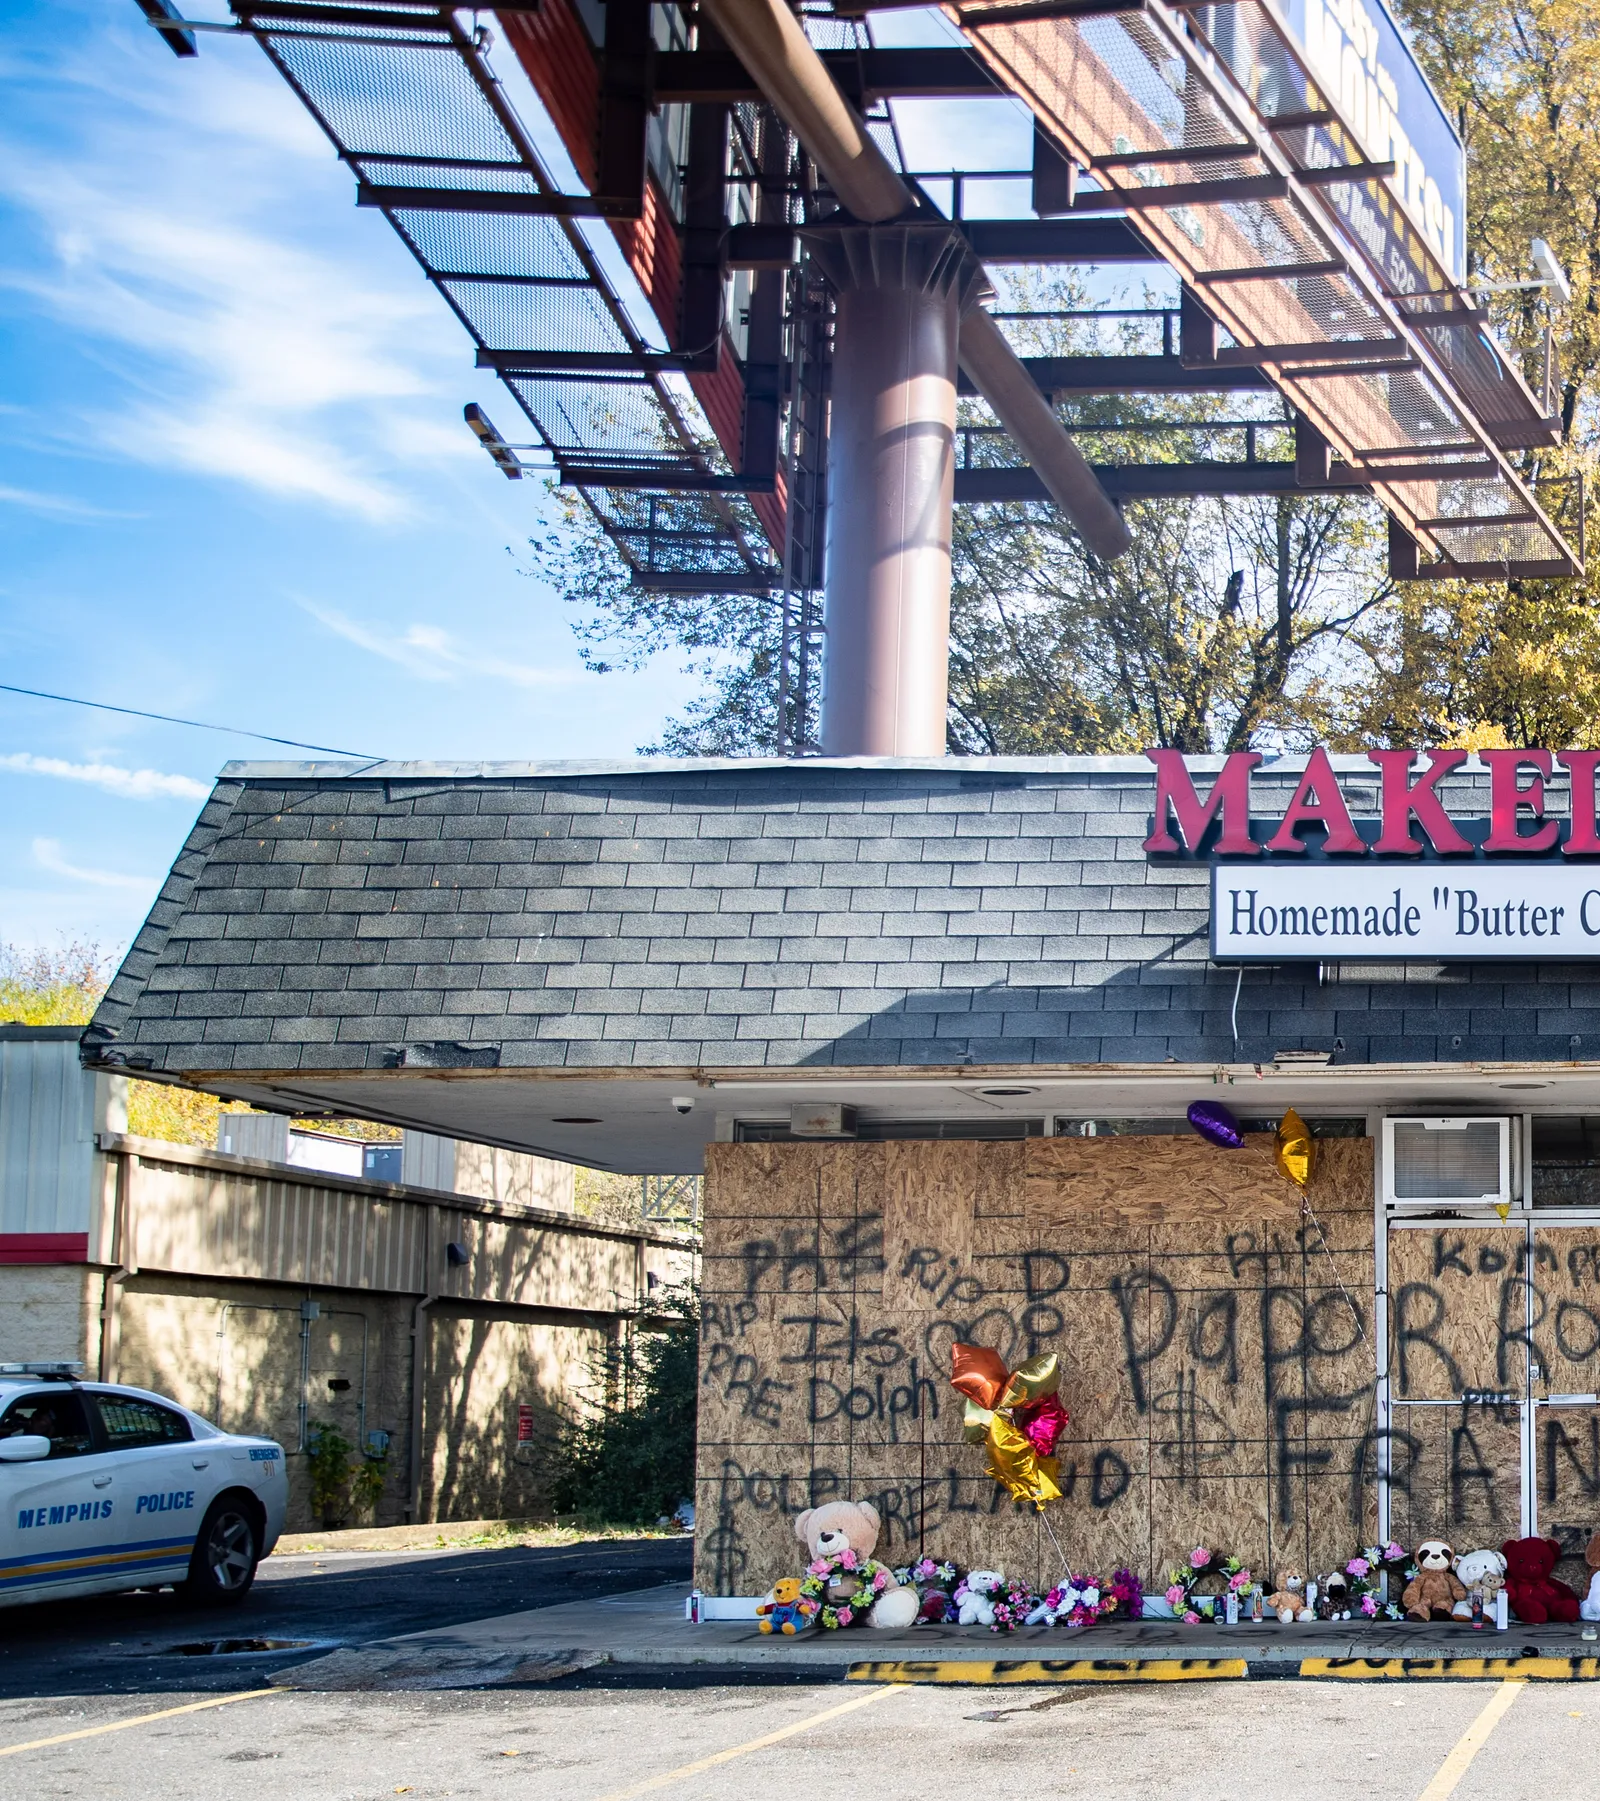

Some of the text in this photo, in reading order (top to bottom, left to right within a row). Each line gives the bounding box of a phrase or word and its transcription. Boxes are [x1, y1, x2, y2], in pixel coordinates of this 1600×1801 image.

[1229, 889, 1421, 937] Homemade
[1433, 886, 1564, 937] "Butter
[701, 1300, 758, 1341] RIP
[809, 1357, 938, 1443] Dolph
[249, 1448, 281, 1461] EMERGENCY
[263, 1460, 275, 1476] 911
[18, 1491, 195, 1528] MEMPHIS POLICE
